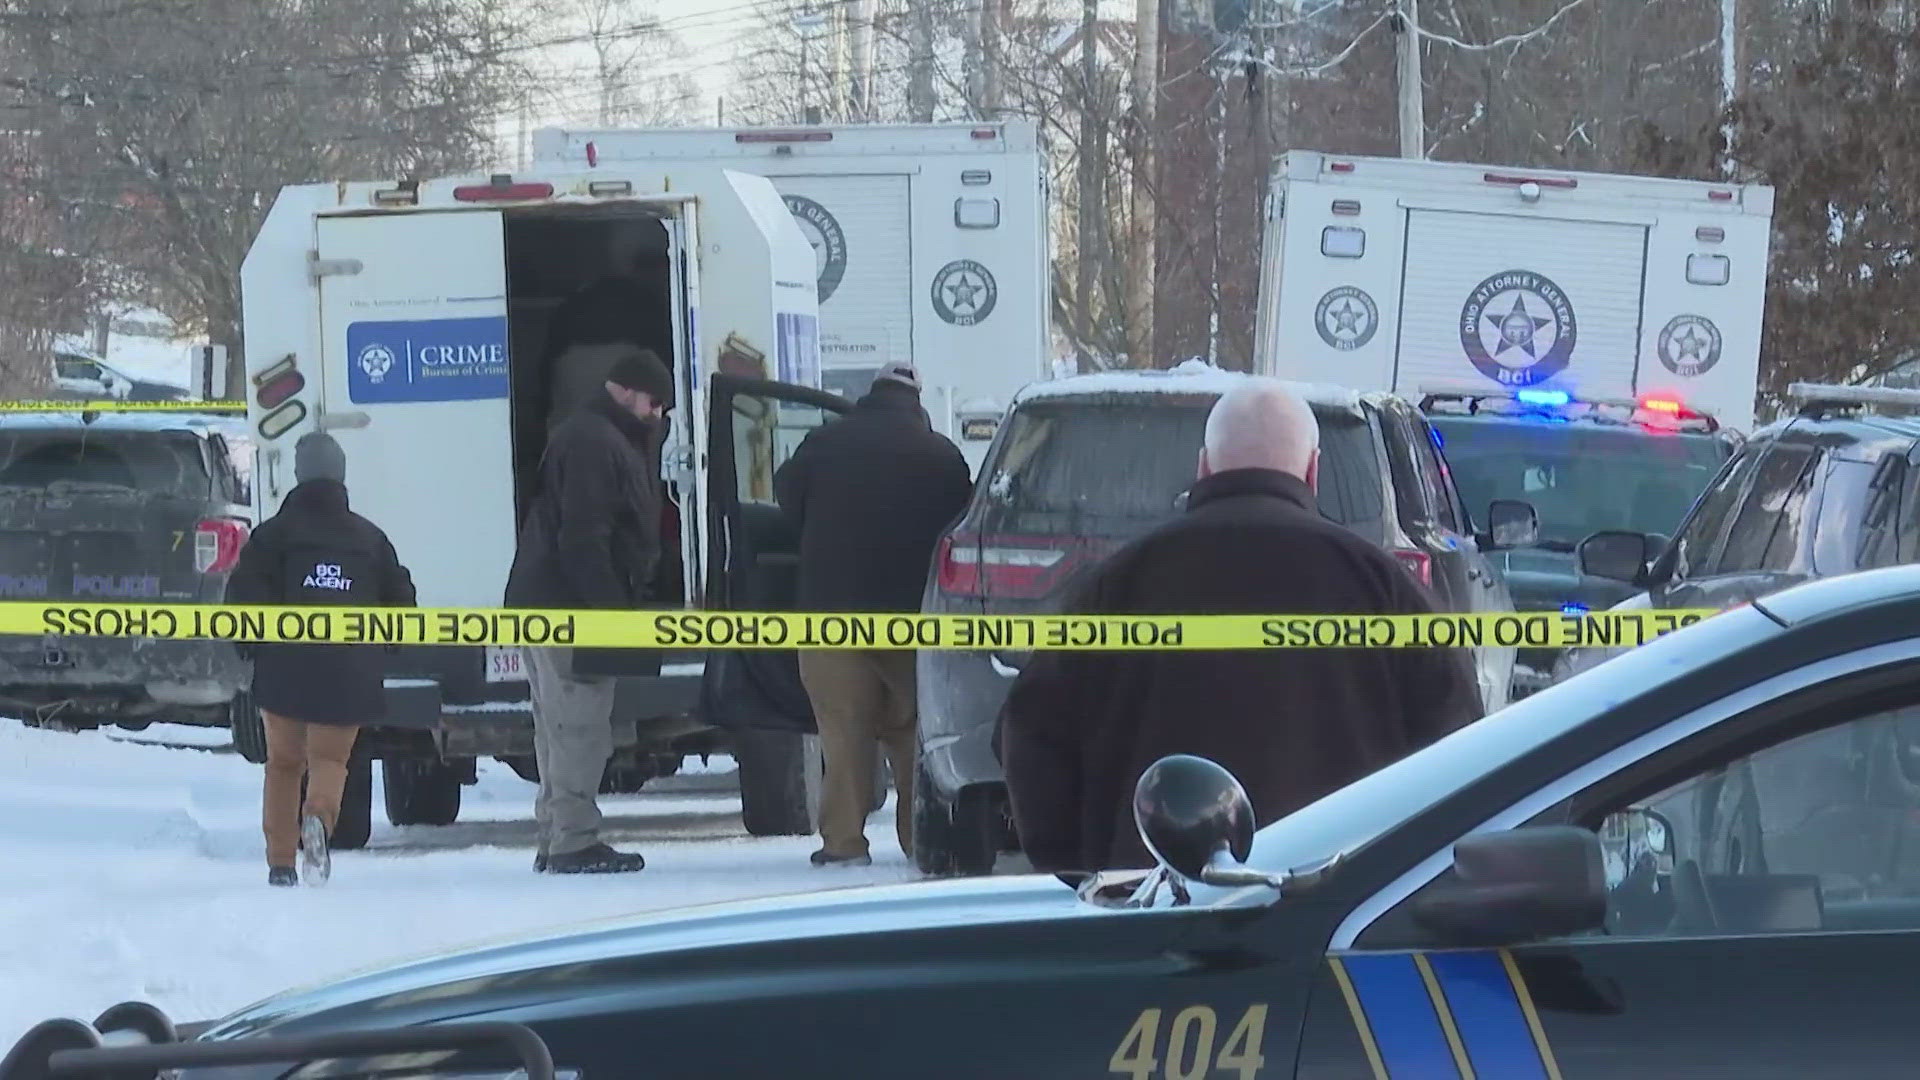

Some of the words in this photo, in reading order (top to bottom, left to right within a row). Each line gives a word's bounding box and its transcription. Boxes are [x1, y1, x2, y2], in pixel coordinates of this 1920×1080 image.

[807, 207, 842, 262] GENERAL
[1464, 303, 1479, 333] OHIO
[1476, 275, 1541, 303] ATTORNEY
[1541, 284, 1572, 339] GENERAL
[420, 343, 505, 367] CRIME
[421, 365, 460, 378] Bureau
[462, 365, 474, 376] of
[1497, 367, 1533, 385] BCI
[171, 531, 185, 552] 7
[302, 575, 353, 590] AGENT
[316, 564, 341, 577] BCI
[73, 575, 160, 597] POLICE
[42, 608, 177, 639] CROSS
[186, 610, 264, 640] NOT
[276, 610, 331, 641] DO
[343, 612, 425, 642] LINE
[437, 613, 575, 644] POLICE
[654, 614, 788, 645] CROSS
[796, 616, 875, 646] NOT
[887, 617, 940, 646] DO
[952, 618, 1034, 646] LINE
[1046, 619, 1182, 646] POLICE
[1261, 617, 1396, 648] CROSS
[1404, 617, 1482, 648] NOT
[1494, 616, 1549, 647] DO
[1560, 614, 1644, 646] LINE
[493, 654, 519, 673] S38
[1108, 1003, 1269, 1080] 404
